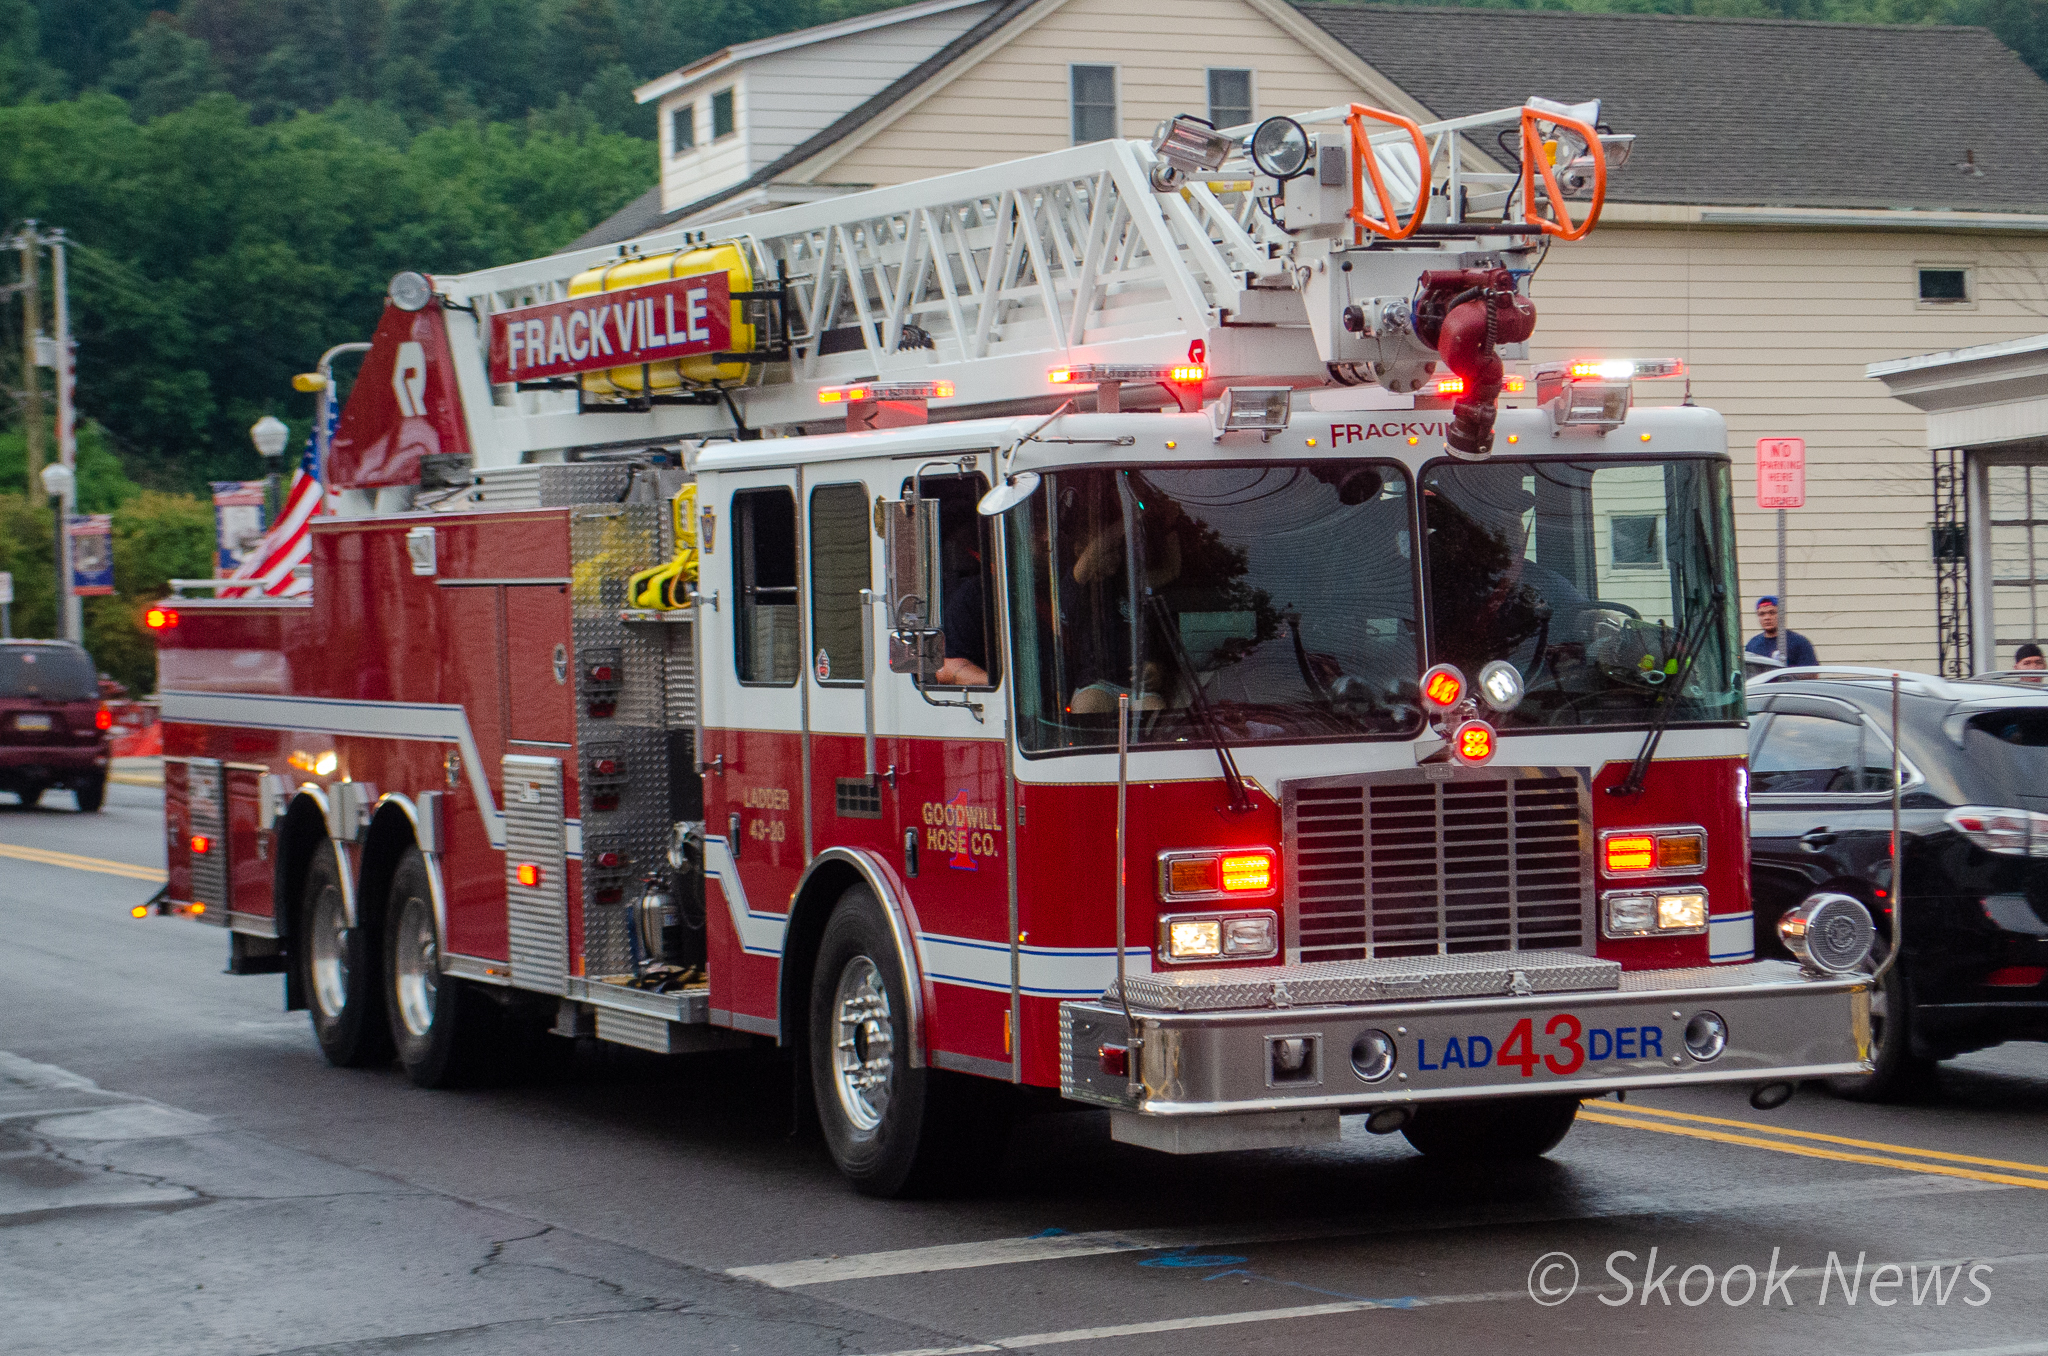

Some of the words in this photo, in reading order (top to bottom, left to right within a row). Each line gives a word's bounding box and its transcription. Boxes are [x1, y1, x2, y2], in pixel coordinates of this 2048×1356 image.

[507, 287, 709, 370] FRACKVILLE
[1770, 444, 1792, 457] NO
[1760, 460, 1802, 470] PARKING
[1767, 472, 1794, 482] HERE
[1775, 484, 1789, 494] TO
[1763, 496, 1799, 506] CORNER
[742, 787, 790, 810] LADDER
[922, 802, 1002, 831] GOODWILL
[926, 827, 967, 855] HOSE
[971, 832, 998, 857] CO.
[1496, 1014, 1585, 1077] 43
